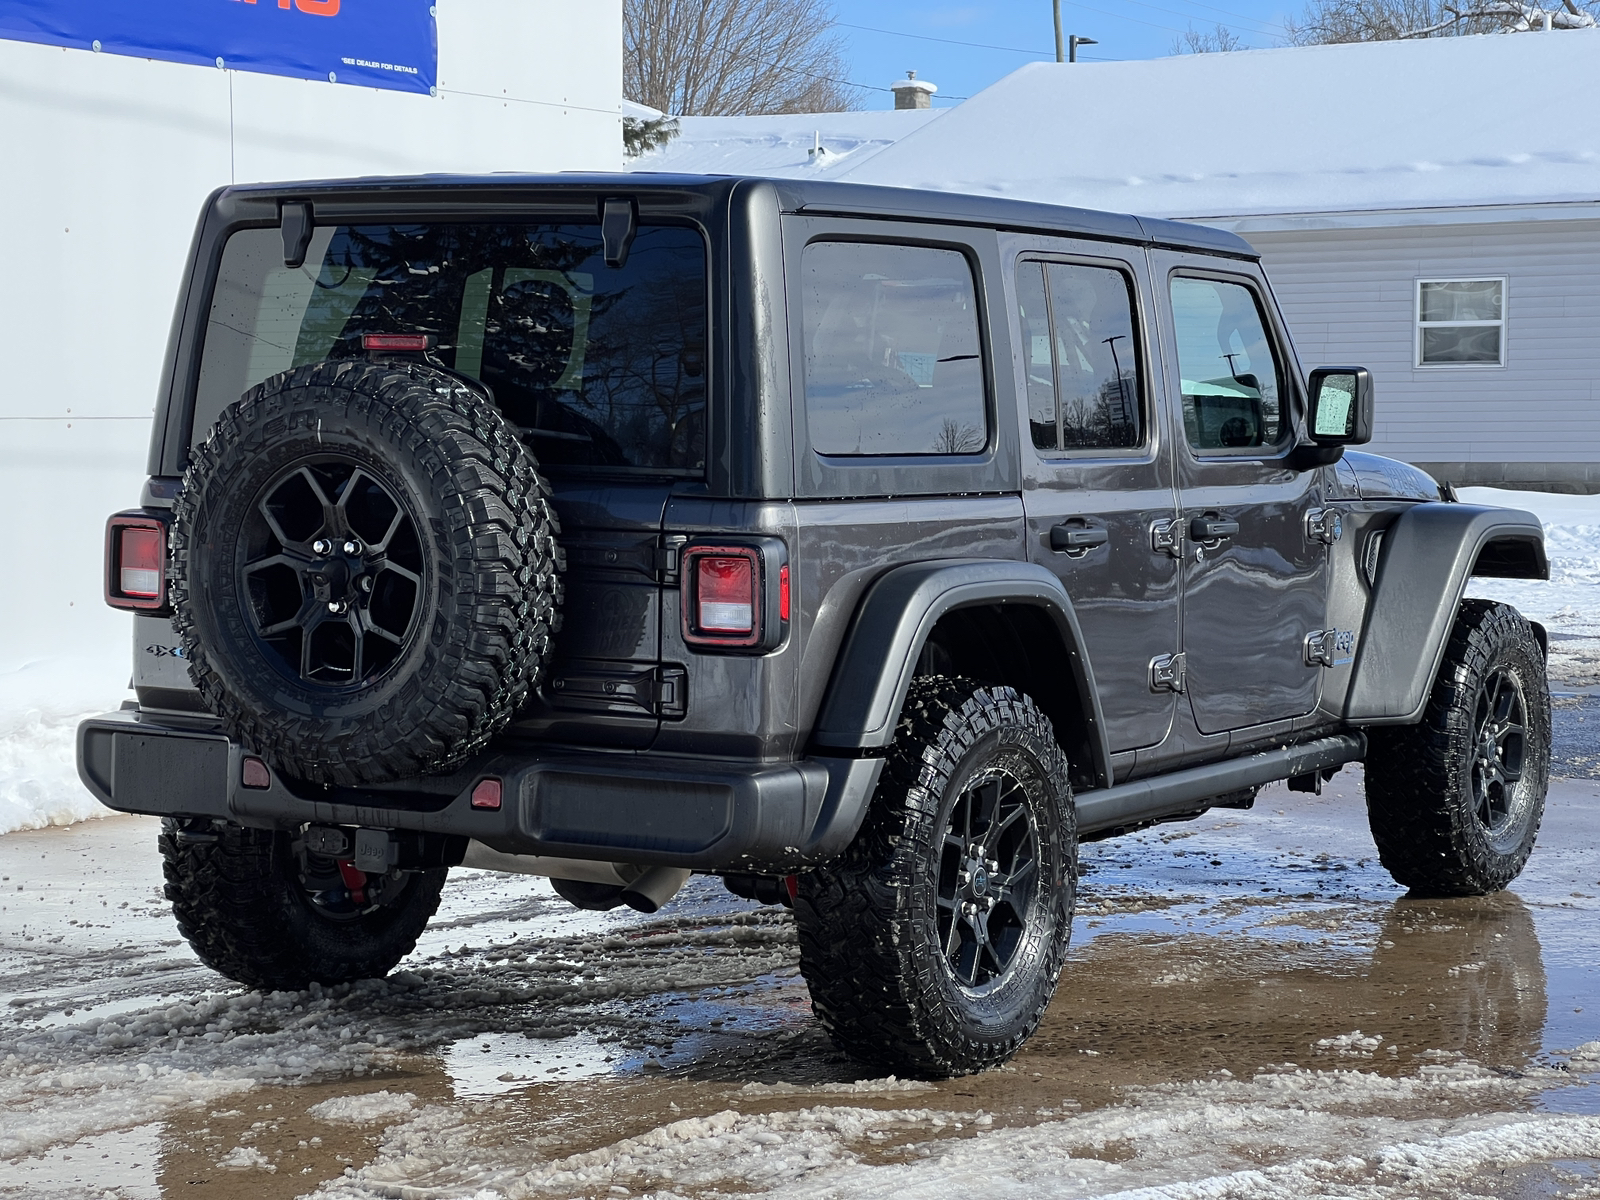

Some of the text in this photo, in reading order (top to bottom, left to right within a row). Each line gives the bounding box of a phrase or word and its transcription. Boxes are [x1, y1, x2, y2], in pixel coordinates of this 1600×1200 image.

[356, 59, 380, 69] DEALER
[394, 65, 418, 74] DETAILS
[196, 407, 318, 546] FALKEN
[360, 843, 385, 859] Jeep
